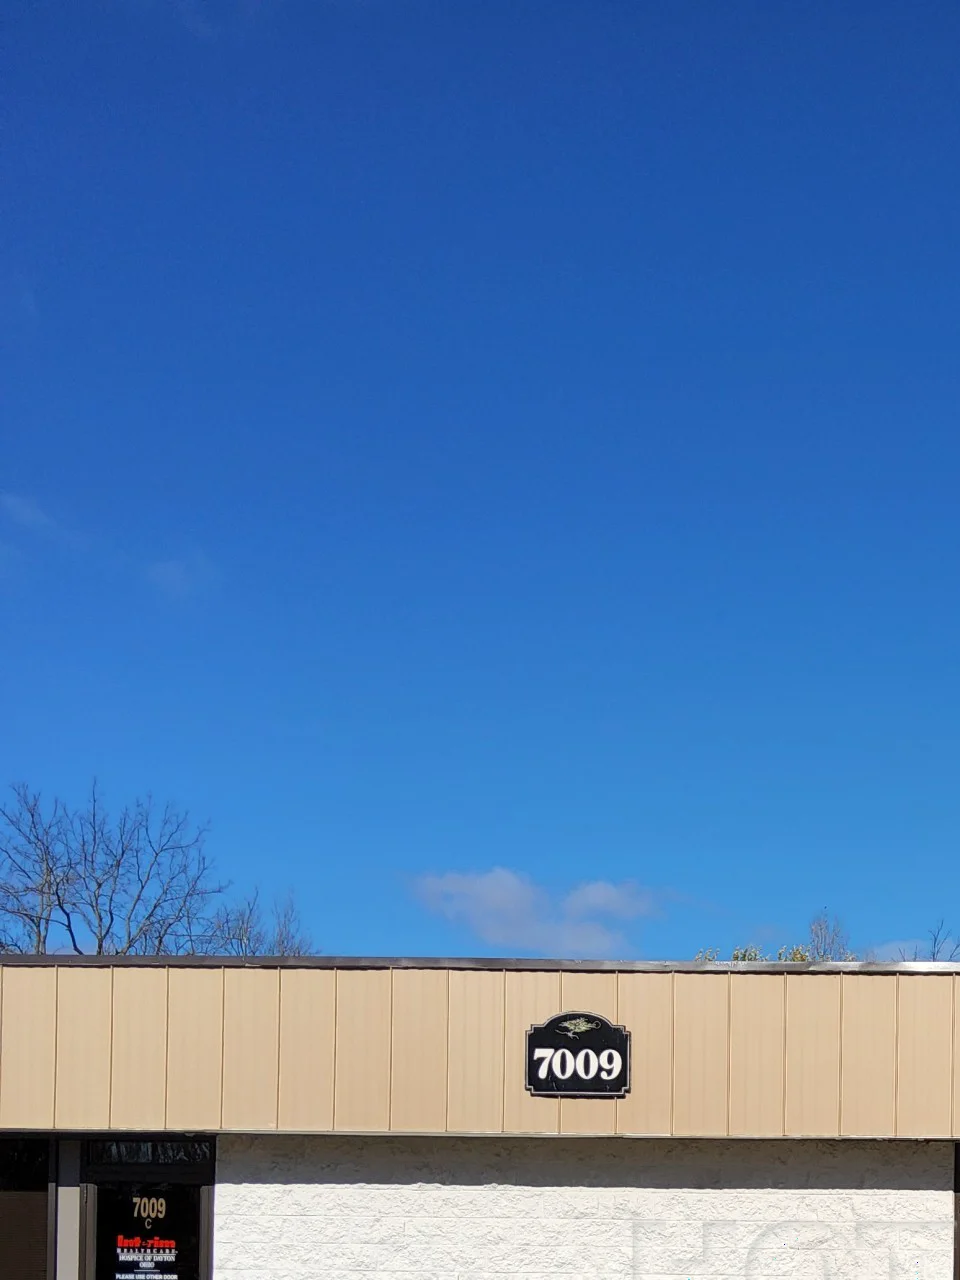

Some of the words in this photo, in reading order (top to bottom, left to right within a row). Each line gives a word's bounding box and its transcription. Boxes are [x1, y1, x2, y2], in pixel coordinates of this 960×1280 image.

[533, 1048, 622, 1080] 7009
[132, 1197, 166, 1218] 7009
[144, 1218, 152, 1229] C
